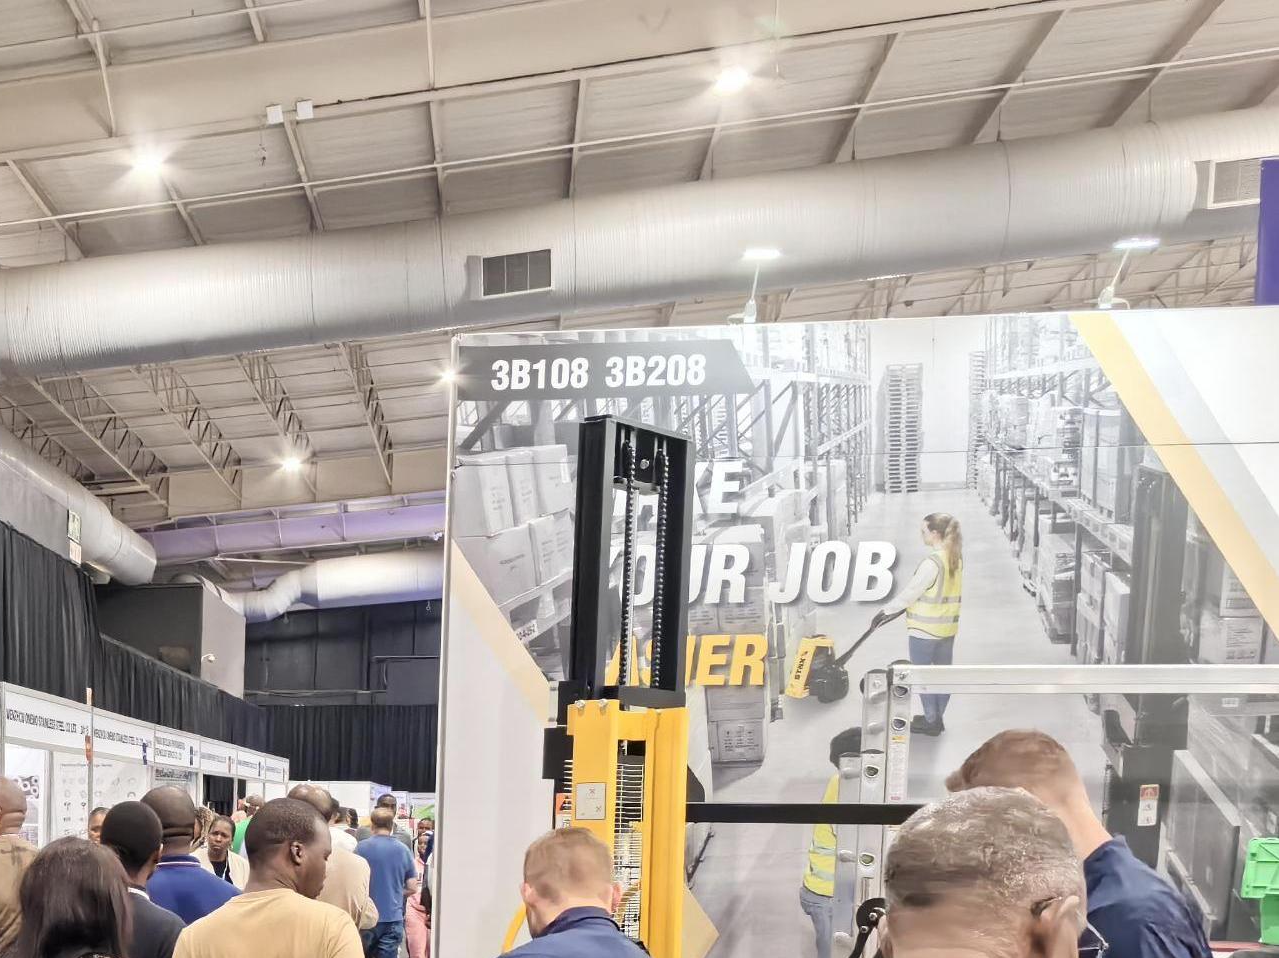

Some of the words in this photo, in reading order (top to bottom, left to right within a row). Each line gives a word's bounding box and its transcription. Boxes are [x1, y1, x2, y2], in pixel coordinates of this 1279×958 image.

[490, 357, 589, 391] 3B108
[605, 353, 707, 388] 3B208
[772, 540, 897, 604] JOB
